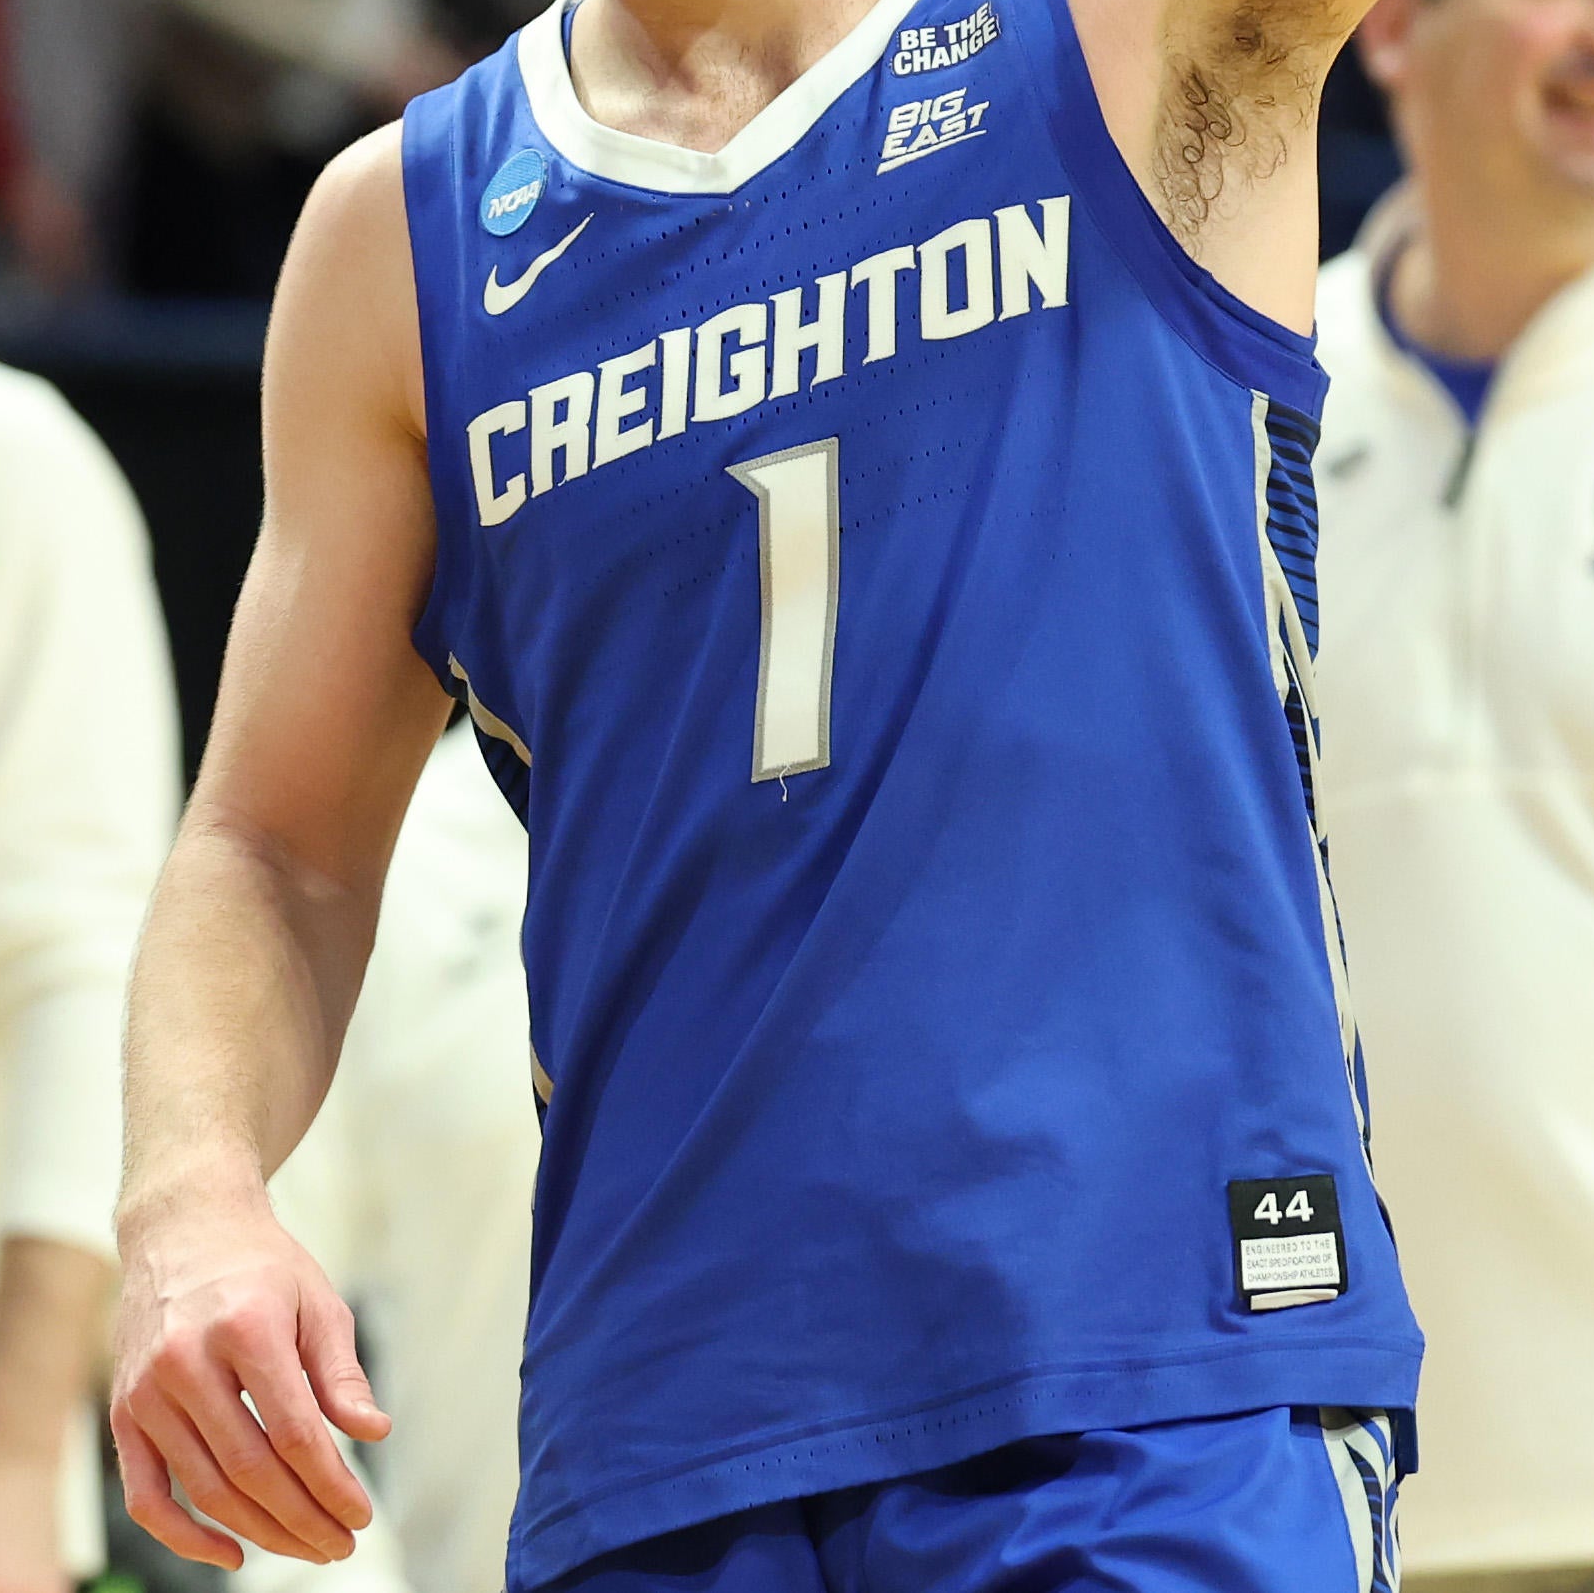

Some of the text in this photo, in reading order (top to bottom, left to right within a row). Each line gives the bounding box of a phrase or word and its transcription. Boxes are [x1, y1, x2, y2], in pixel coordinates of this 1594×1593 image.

[893, 16, 998, 76] CHANGE
[900, 1, 989, 50] BE THE
[881, 101, 990, 160] EAST
[888, 87, 967, 133] BIG
[488, 180, 541, 219] NCAA
[465, 195, 1071, 527] CREIGHTON
[725, 436, 839, 784] 1
[1254, 1190, 1314, 1225] 44
